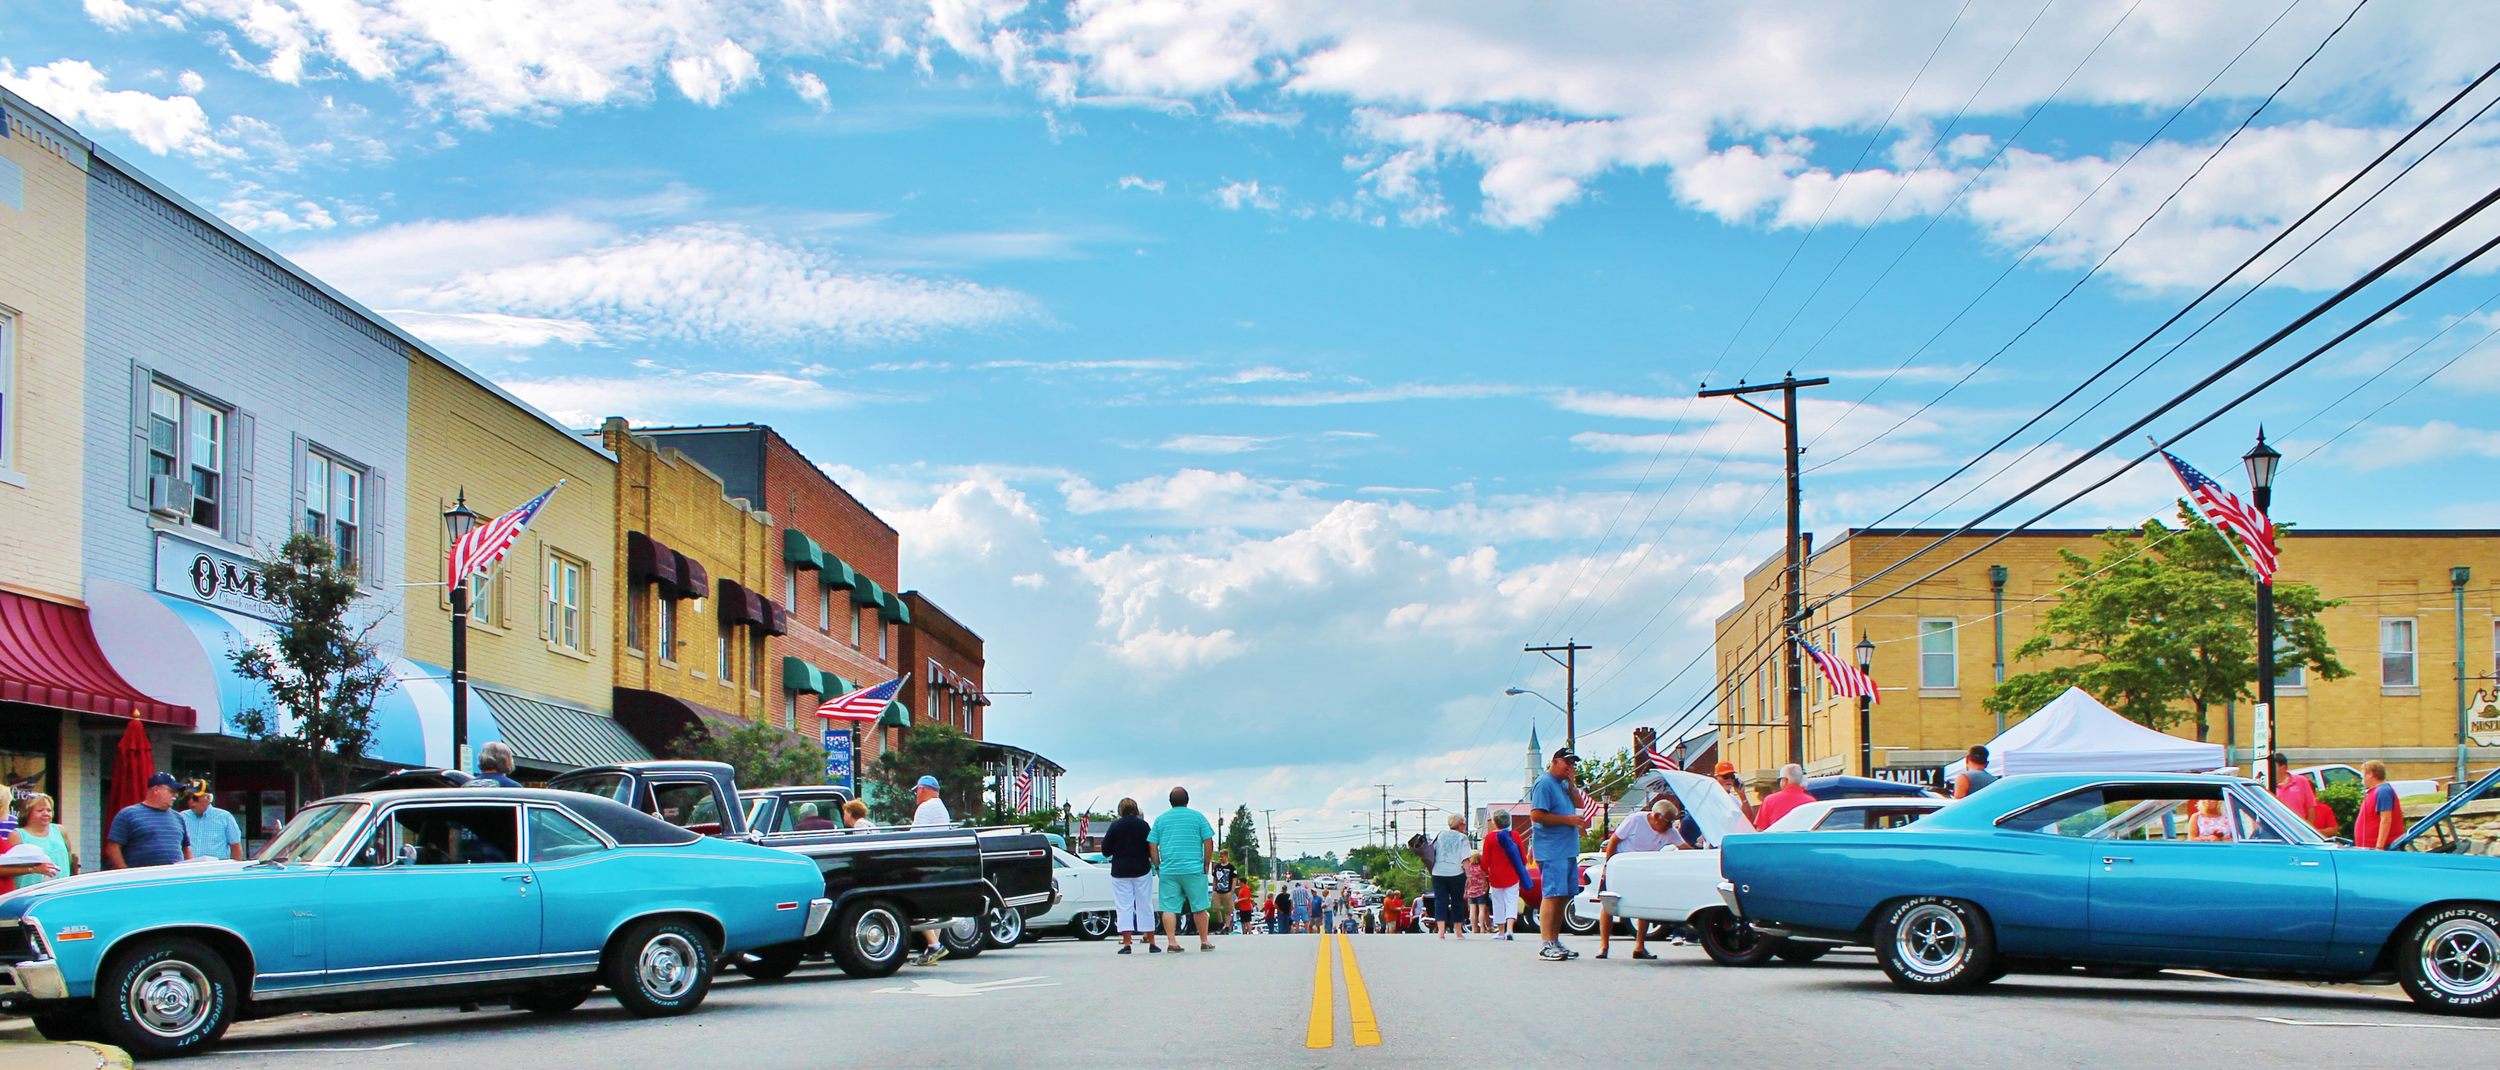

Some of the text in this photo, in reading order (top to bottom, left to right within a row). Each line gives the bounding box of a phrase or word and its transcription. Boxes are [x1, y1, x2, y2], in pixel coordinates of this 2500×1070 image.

[219, 591, 243, 607] Church
[244, 602, 257, 611] and
[1875, 769, 1936, 785] FAMILY
[1890, 896, 1937, 925] WINNER
[2426, 909, 2499, 926] WINSTON
[62, 925, 89, 933] 350
[659, 926, 707, 974] MASTERCRAFT
[1904, 963, 1965, 983] WINSTON
[120, 950, 172, 1021] MASTERCRAFT
[2448, 984, 2500, 1004] INNER
[202, 982, 223, 1034] AVENGER
